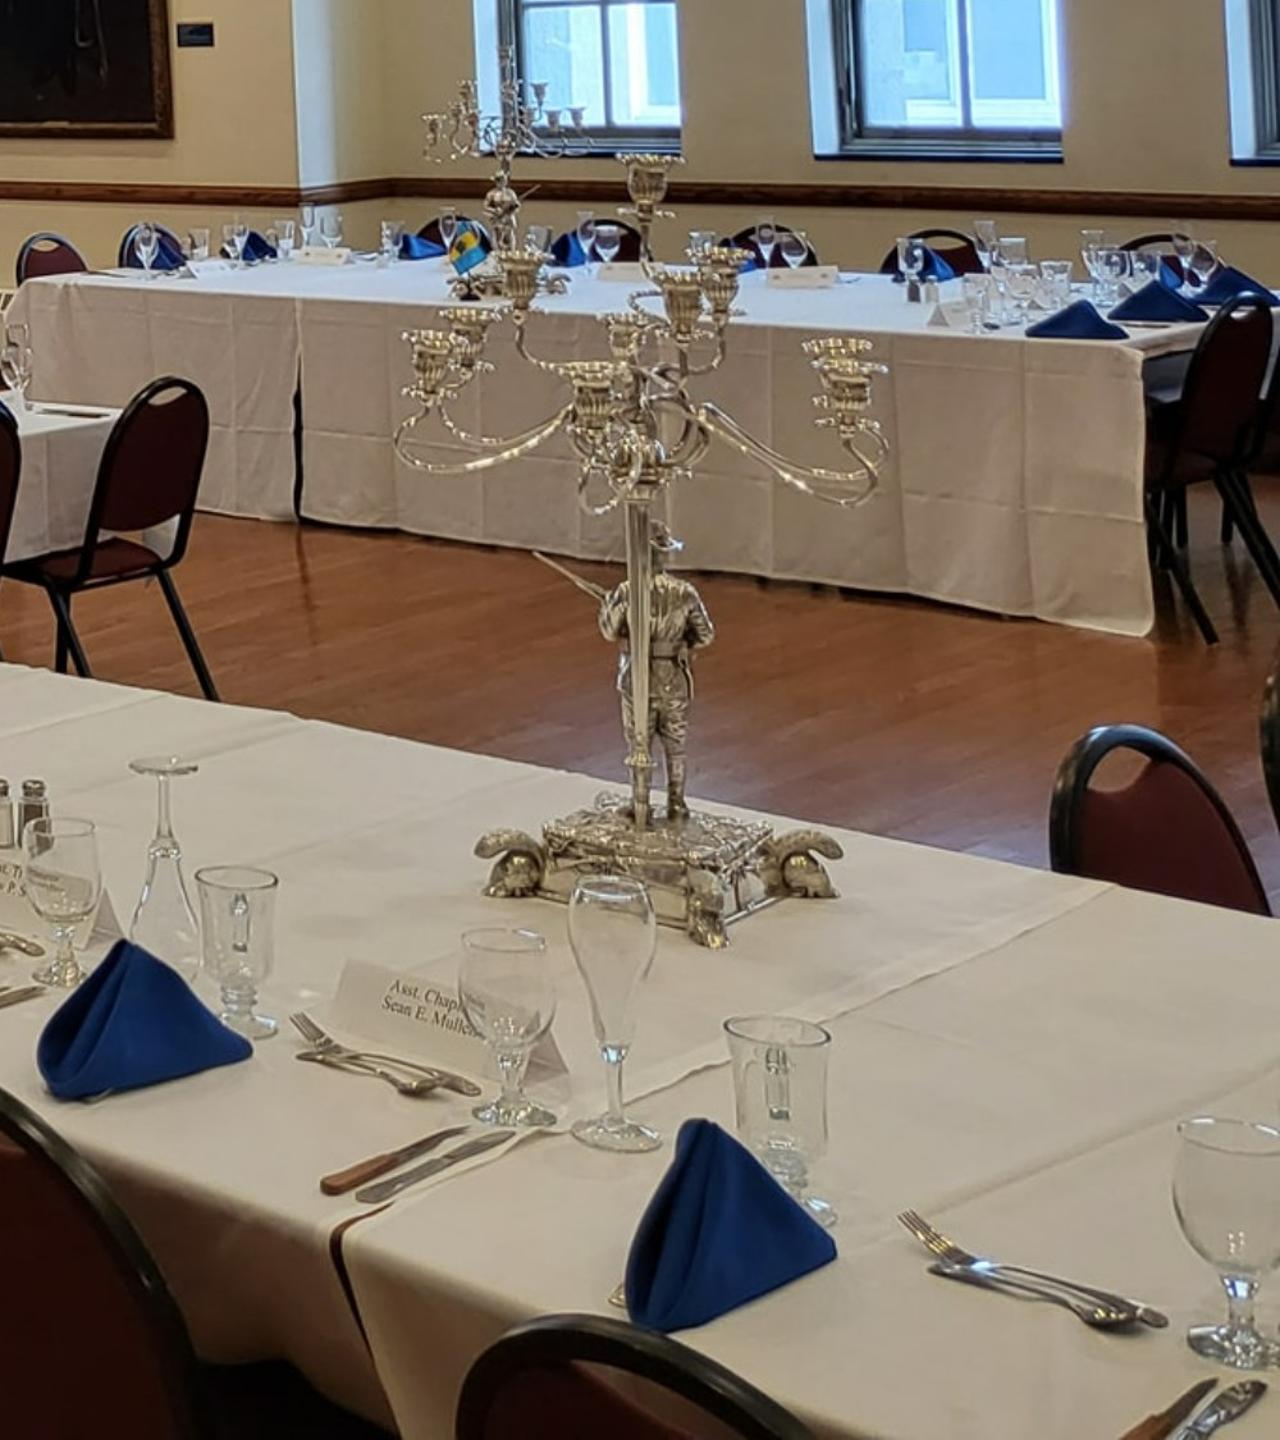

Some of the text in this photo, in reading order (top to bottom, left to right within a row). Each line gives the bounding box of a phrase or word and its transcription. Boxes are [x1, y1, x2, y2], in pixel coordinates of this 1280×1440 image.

[390, 978, 420, 998] Asst.
[381, 994, 412, 1018] Sean
[414, 1005, 429, 1023] E.
